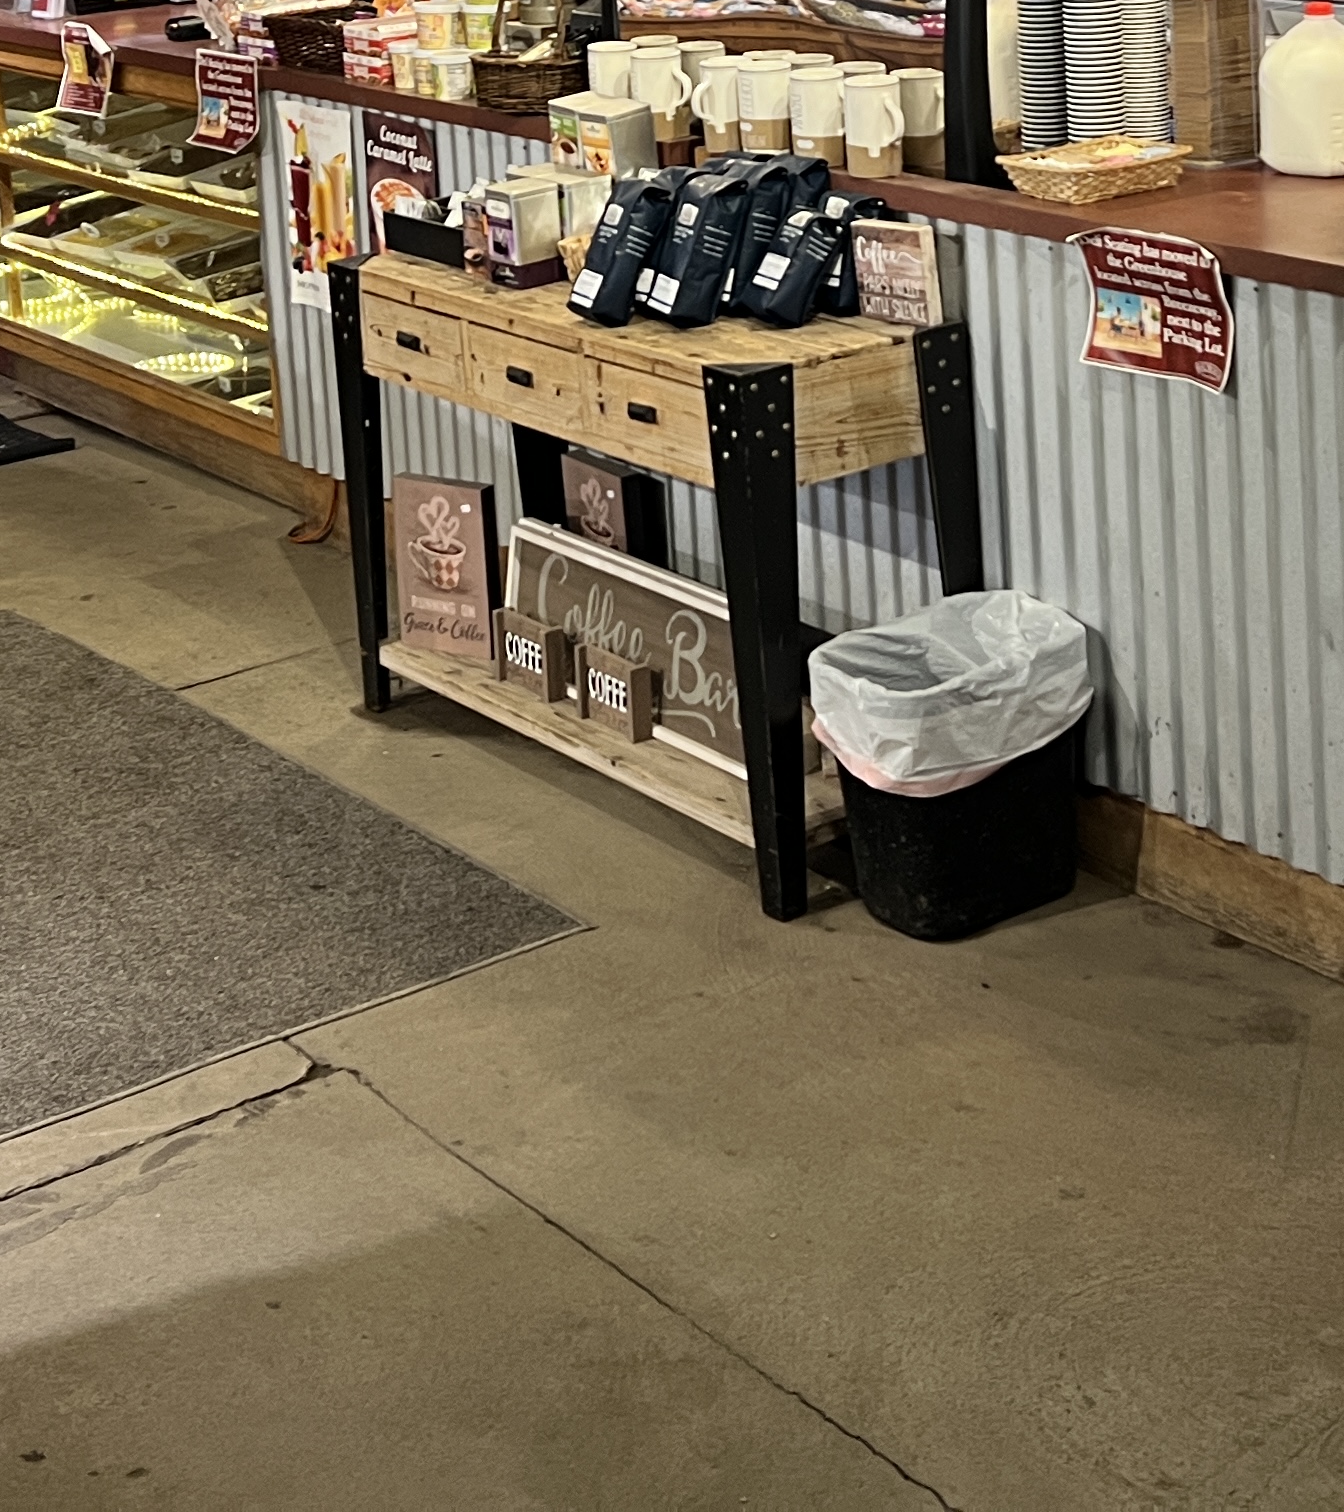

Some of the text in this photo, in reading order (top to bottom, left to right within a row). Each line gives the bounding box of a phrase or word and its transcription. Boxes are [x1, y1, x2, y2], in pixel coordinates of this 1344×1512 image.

[380, 125, 418, 150] Coconut
[367, 140, 407, 166] Caramel
[856, 235, 920, 274] Coffee
[1103, 235, 1142, 258] Seating
[1142, 241, 1160, 259] has
[1161, 249, 1198, 267] moved
[1106, 252, 1125, 269] the
[1164, 281, 1193, 299] from
[1192, 287, 1212, 303] the
[1166, 314, 1222, 337] next to the
[1162, 327, 1203, 354] Parking
[537, 552, 652, 662] Coffee
